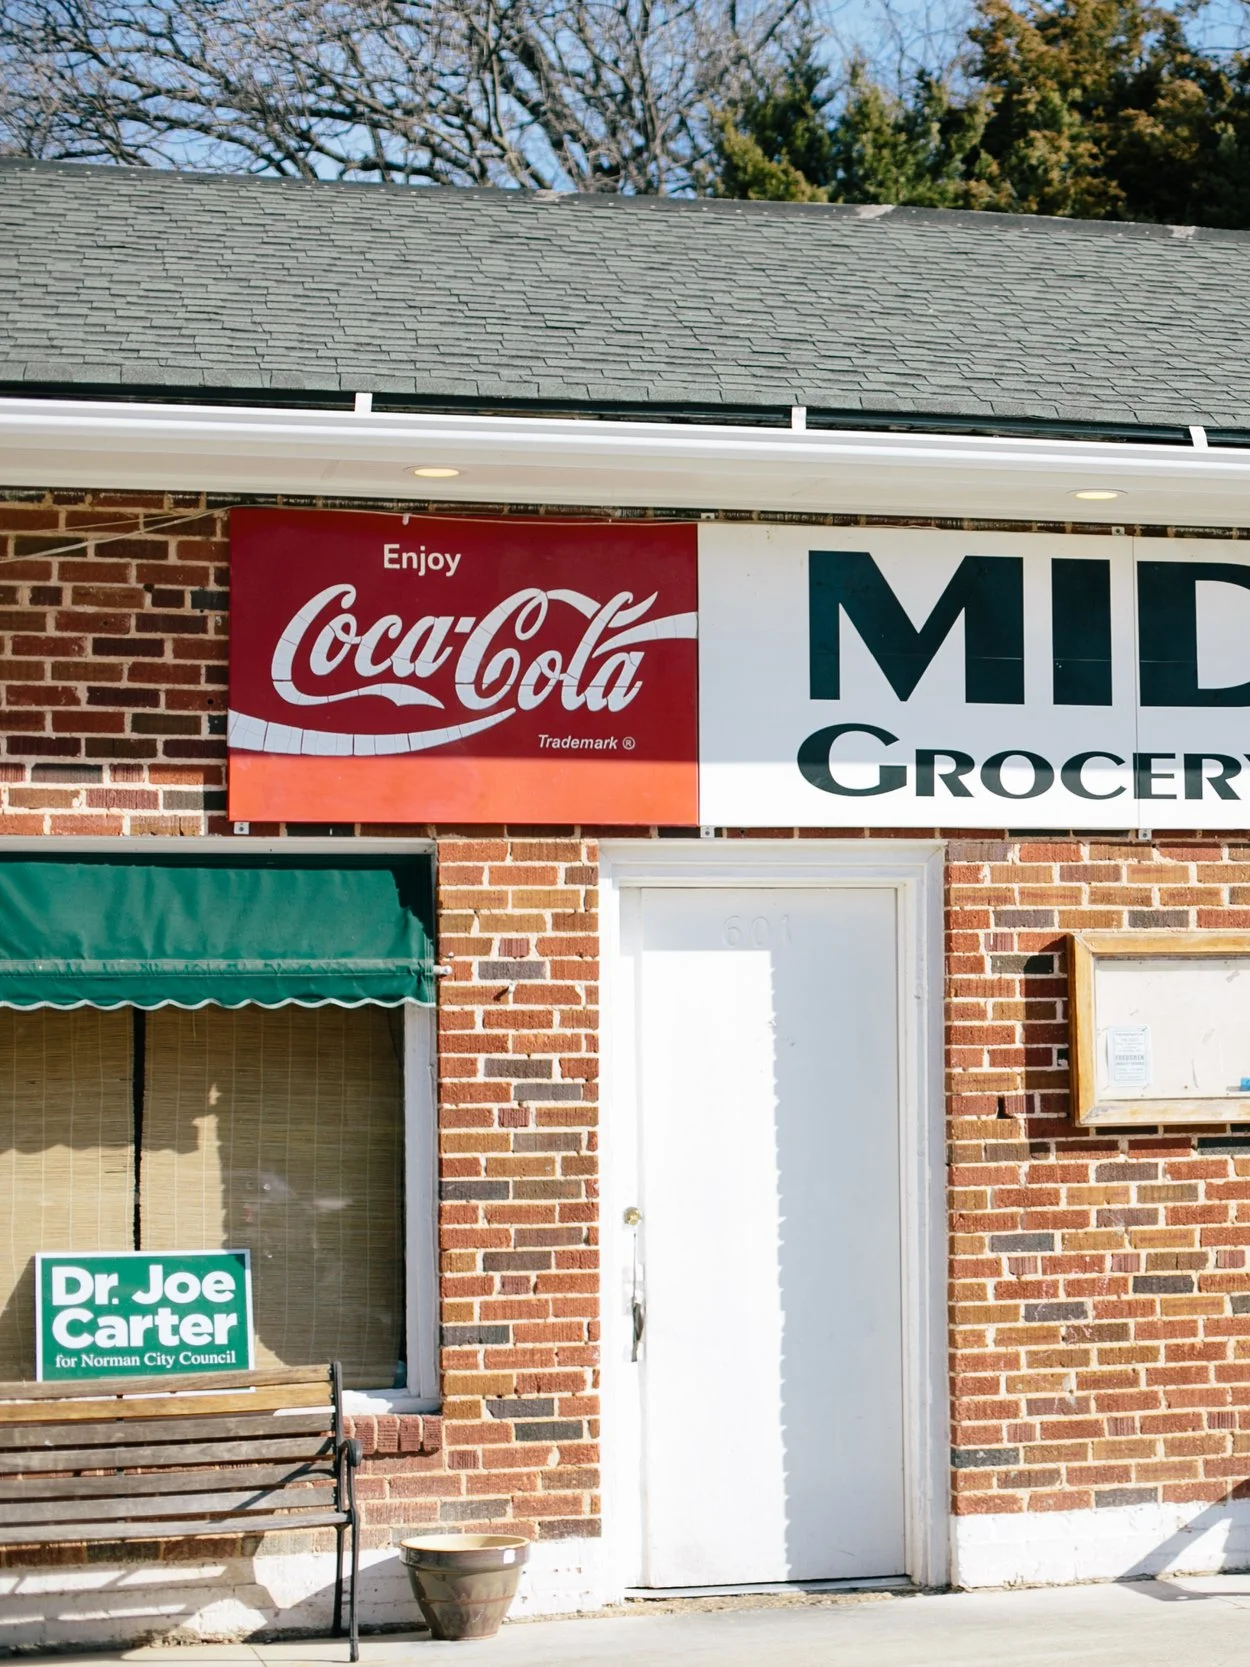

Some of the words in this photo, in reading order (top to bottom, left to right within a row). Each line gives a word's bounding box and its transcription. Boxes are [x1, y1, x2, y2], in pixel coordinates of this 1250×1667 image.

[383, 543, 461, 577] Enjoy
[271, 583, 660, 713] Coca-Cola
[538, 734, 618, 750] Trademark
[721, 914, 793, 948] 601
[52, 1266, 119, 1306] Dr.
[131, 1264, 236, 1305] Joe
[52, 1307, 238, 1349] Carter
[55, 1354, 78, 1368] for
[81, 1354, 140, 1368] Norman
[144, 1352, 175, 1369] City
[179, 1351, 236, 1365] Council
